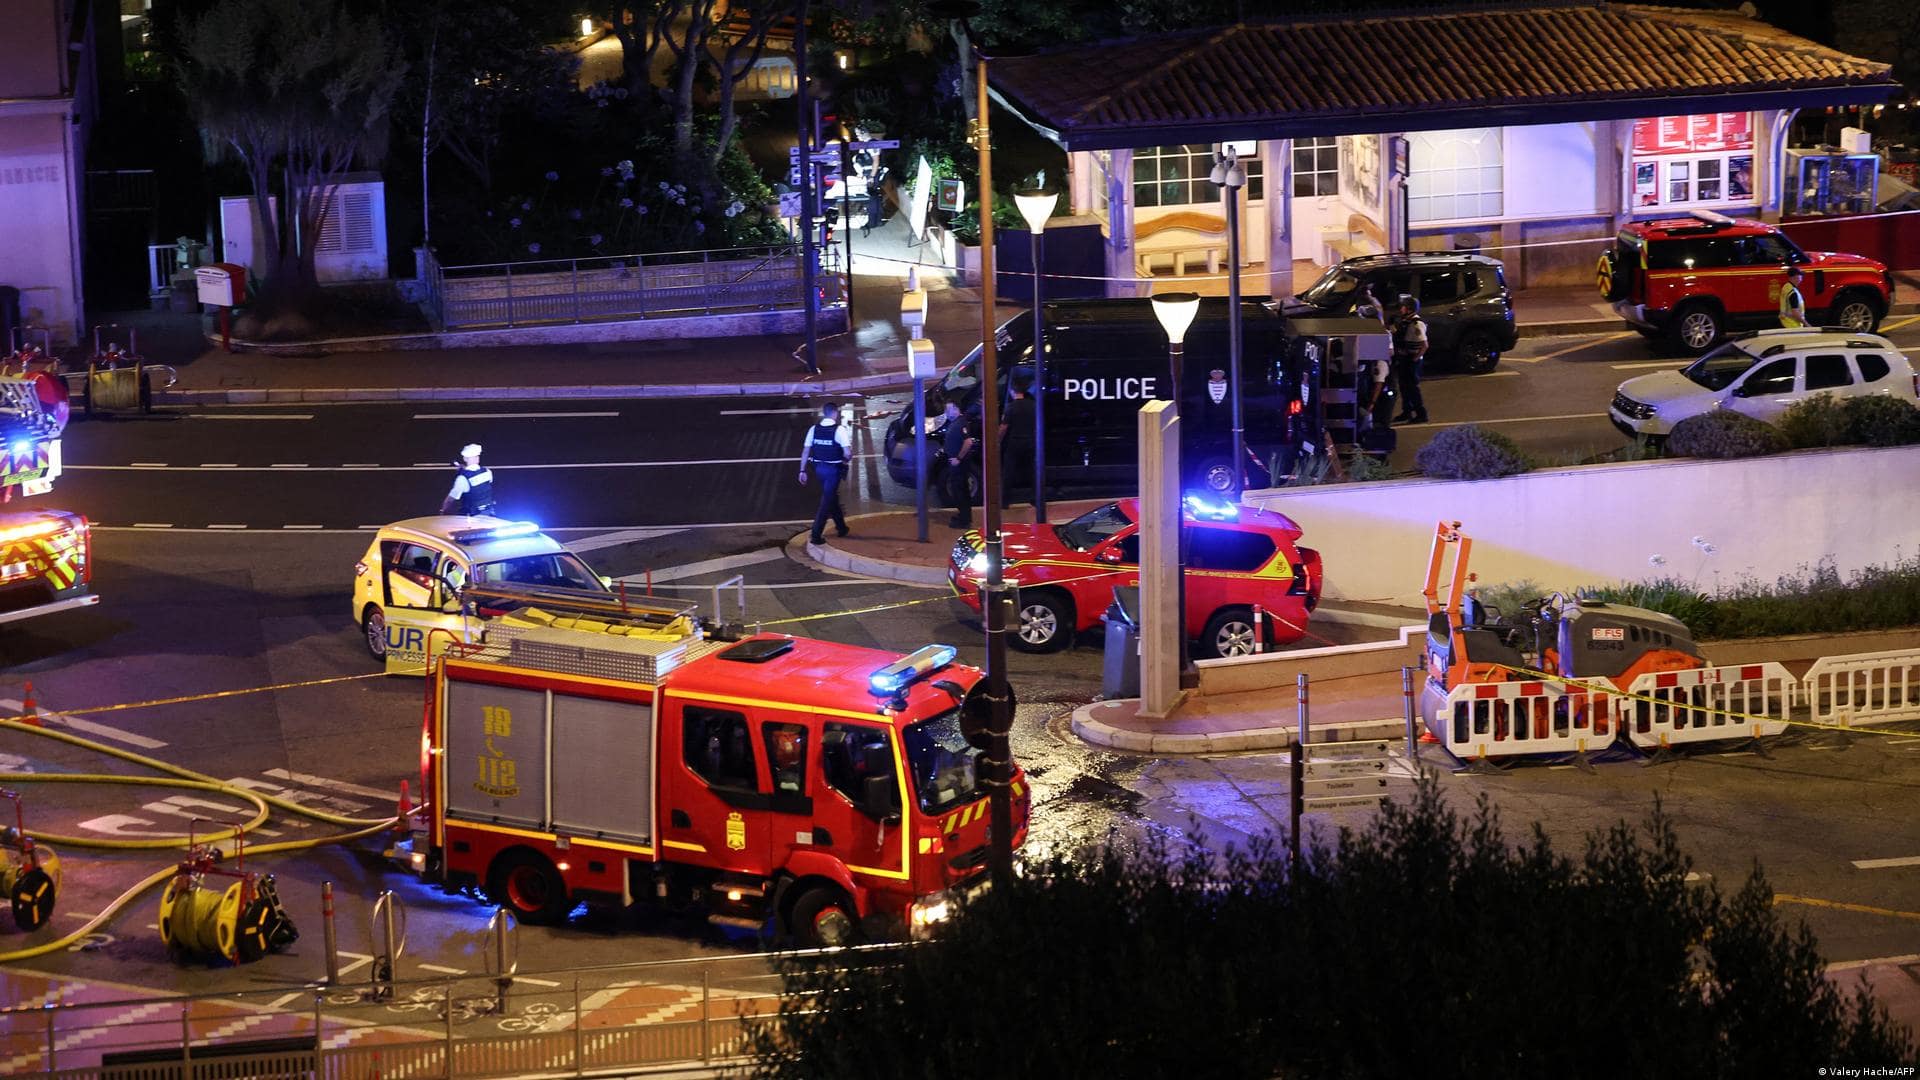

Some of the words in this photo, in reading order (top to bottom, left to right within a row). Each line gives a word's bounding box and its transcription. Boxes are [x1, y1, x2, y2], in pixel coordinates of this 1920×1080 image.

[1064, 377, 1157, 401] POLICE
[480, 705, 512, 737] 18
[478, 754, 516, 787] 112
